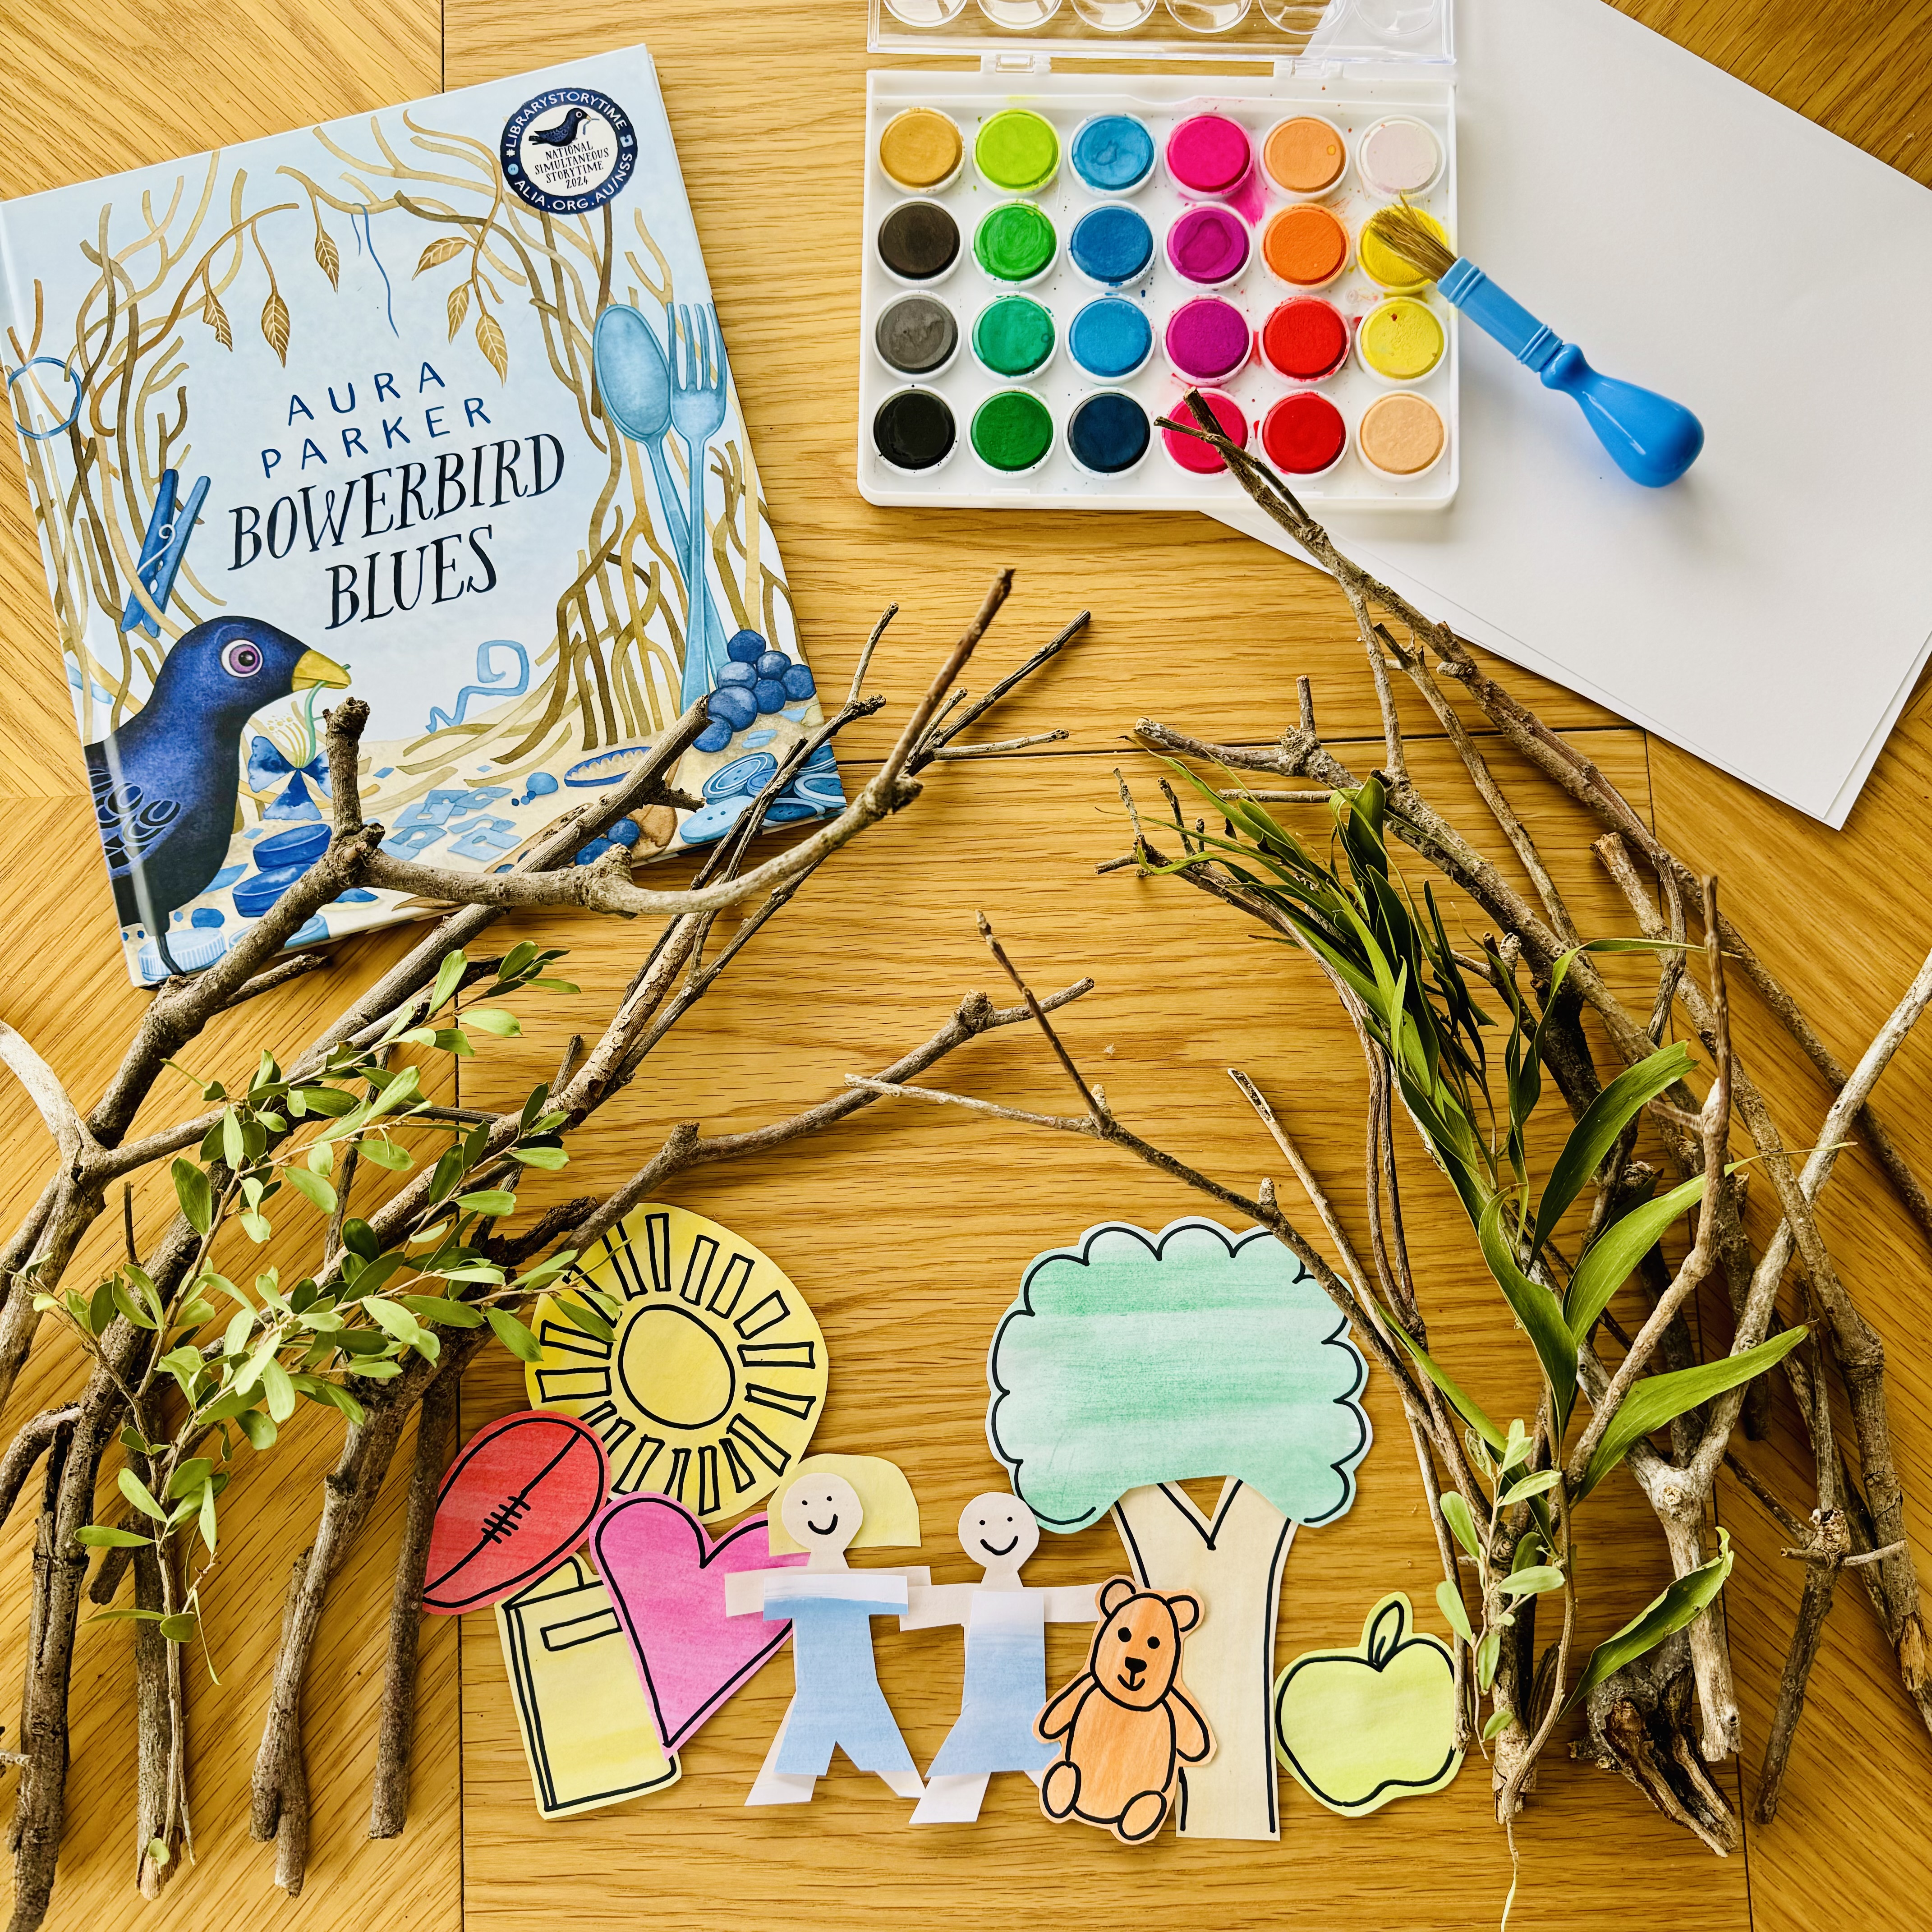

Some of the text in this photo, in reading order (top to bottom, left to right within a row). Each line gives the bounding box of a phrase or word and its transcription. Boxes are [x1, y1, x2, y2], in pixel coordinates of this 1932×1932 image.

[506, 91, 627, 157] #LIBRARYSTORYTIME
[545, 141, 593, 161] NATIONAL
[514, 153, 633, 211] ALIA.ORG.AU/NSS
[534, 147, 609, 175] SIMULTANEOUS
[546, 161, 604, 183] STORYTIME
[566, 176, 589, 189] 2024
[288, 361, 446, 426] AURA
[261, 397, 491, 478] PARKER
[227, 433, 565, 571] BOWERBIRD
[324, 524, 497, 630] BLUES
